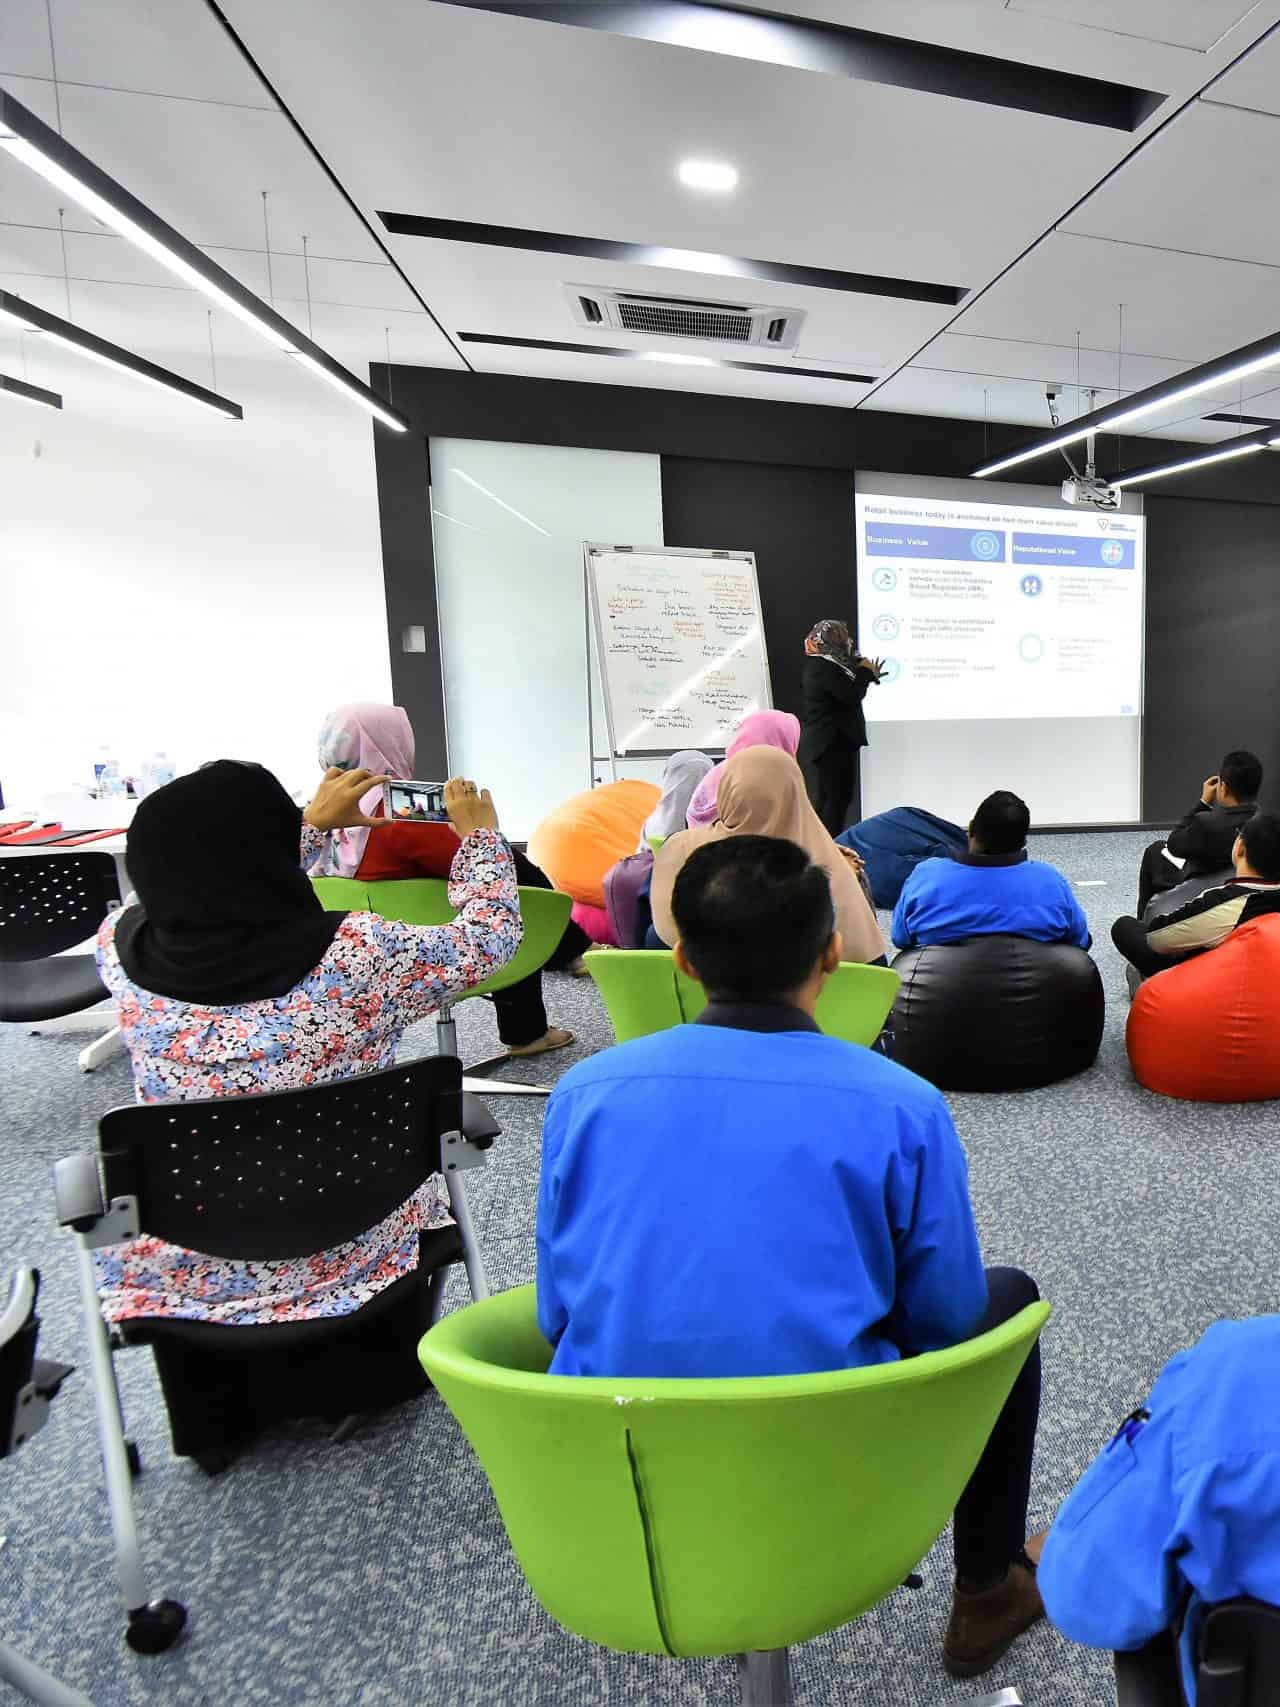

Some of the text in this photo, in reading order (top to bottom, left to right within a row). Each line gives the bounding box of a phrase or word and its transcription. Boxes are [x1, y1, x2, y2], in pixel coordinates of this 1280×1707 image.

[925, 511, 946, 520] today
[867, 535, 929, 546] Business Value
